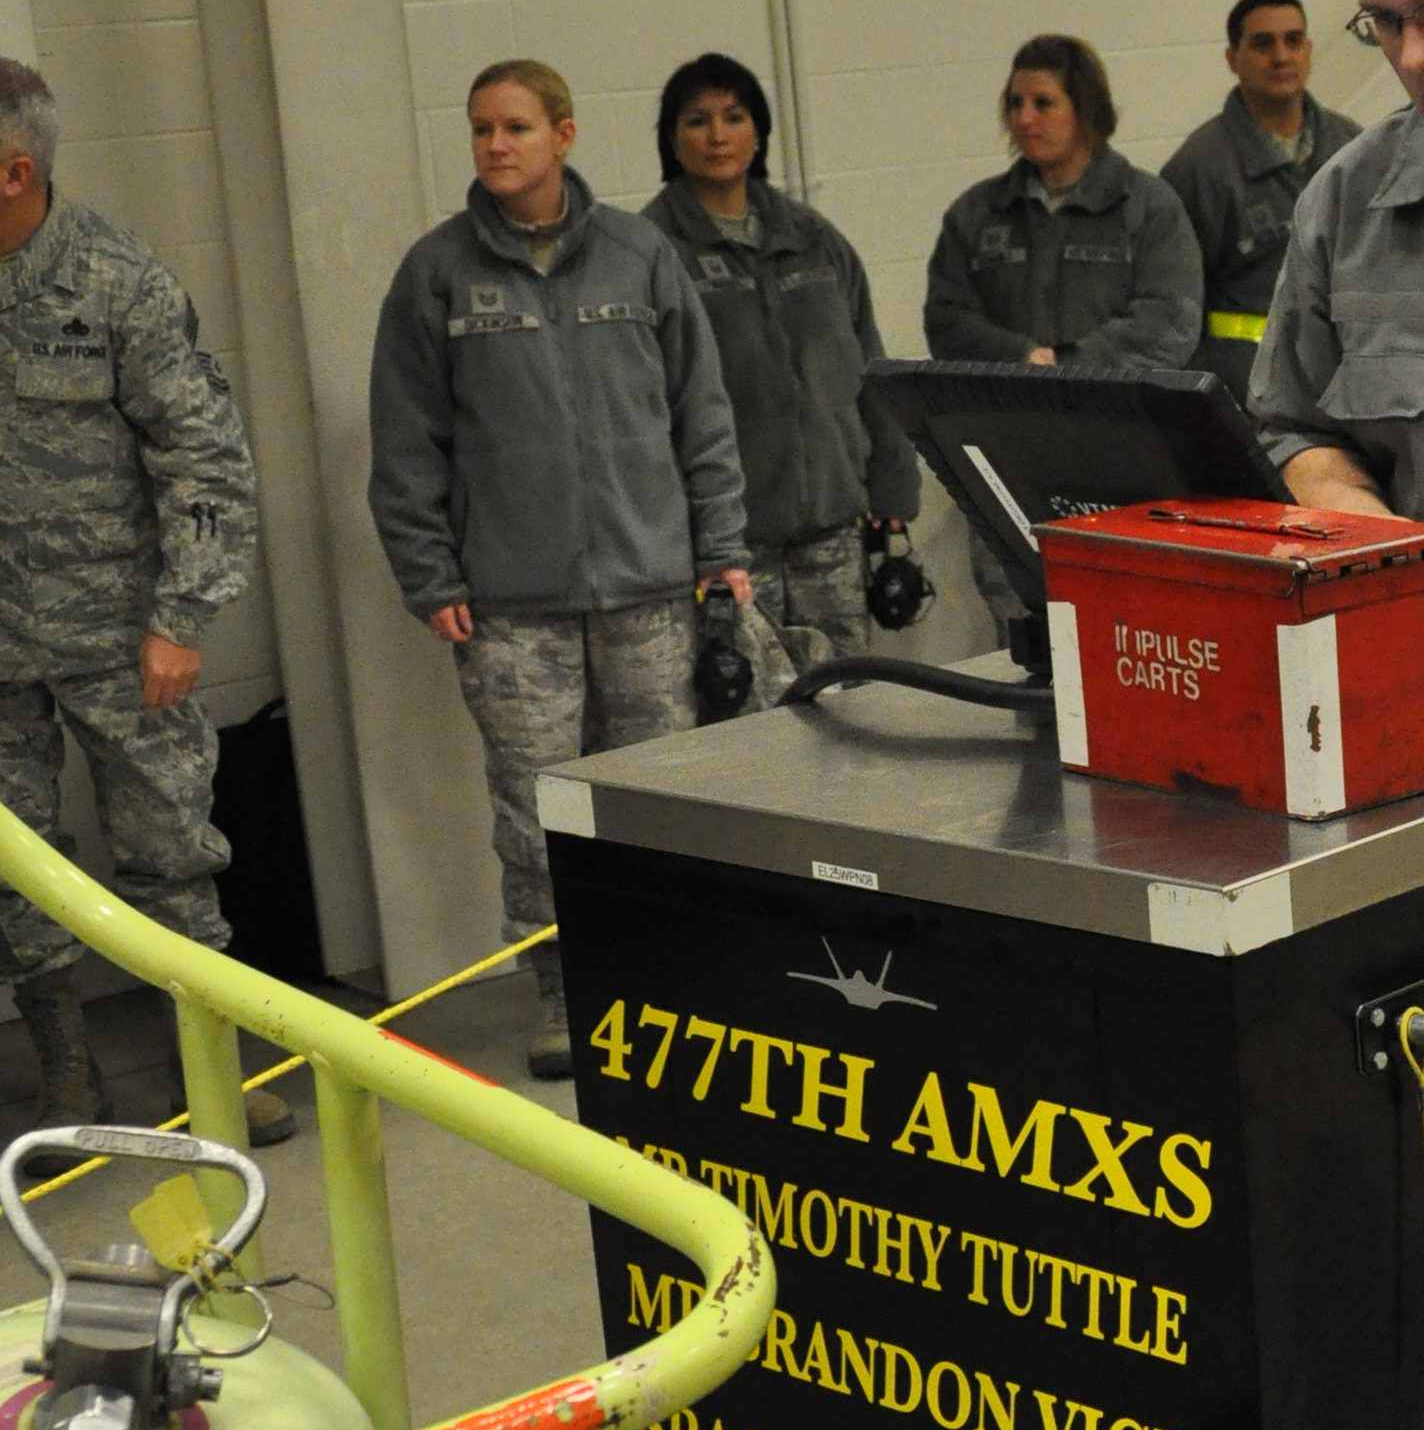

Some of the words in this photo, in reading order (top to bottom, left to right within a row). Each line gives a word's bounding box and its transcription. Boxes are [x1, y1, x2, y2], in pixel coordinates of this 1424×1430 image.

[1116, 656, 1200, 700] CARTS
[145, 1139, 198, 1159] OPEN
[591, 1000, 873, 1142] 477TH
[892, 1072, 1213, 1229] AMXS
[961, 1232, 1188, 1365] TUTTLE
